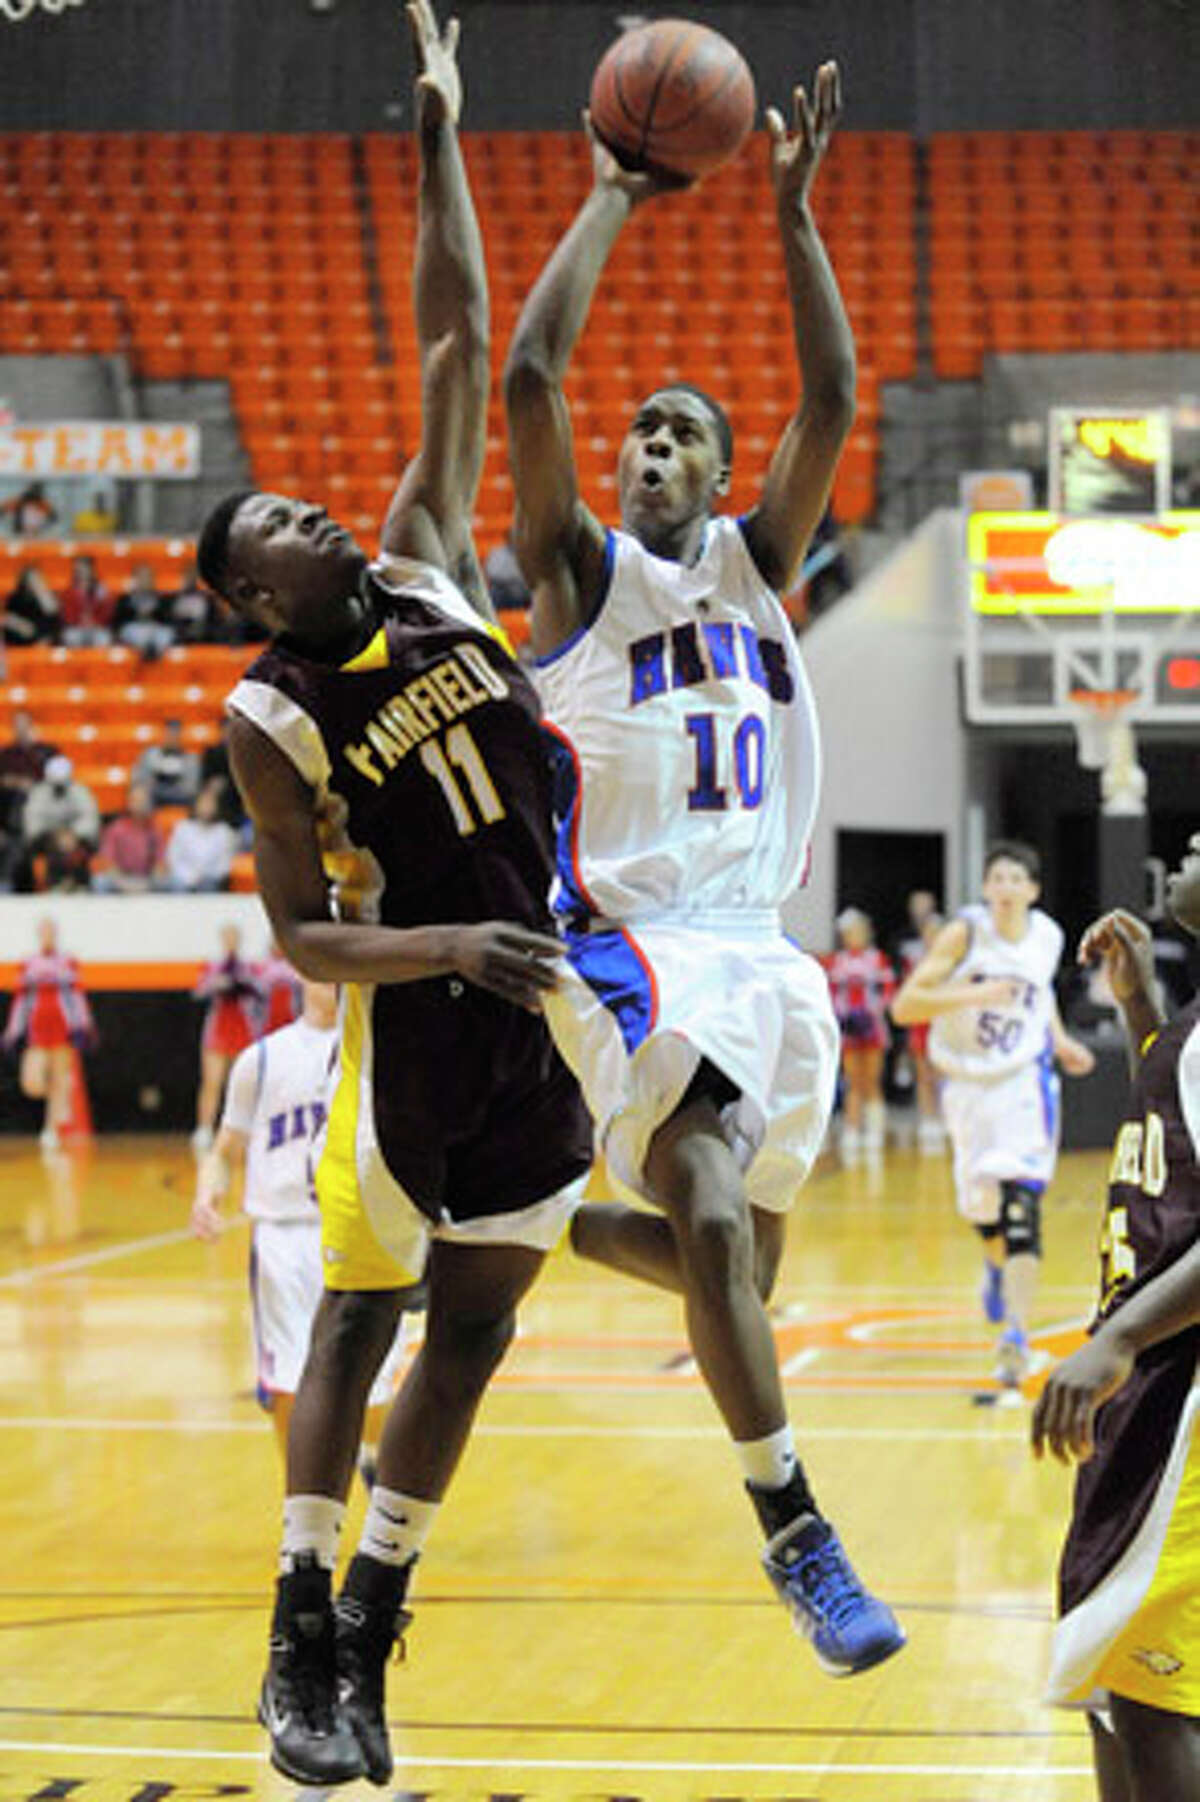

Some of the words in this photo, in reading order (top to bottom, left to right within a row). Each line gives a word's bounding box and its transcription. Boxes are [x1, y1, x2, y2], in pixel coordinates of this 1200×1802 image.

[343, 642, 510, 787] FAIRFIELD
[684, 712, 766, 811] 10
[419, 722, 506, 838] 11
[976, 1010, 1024, 1055] 50
